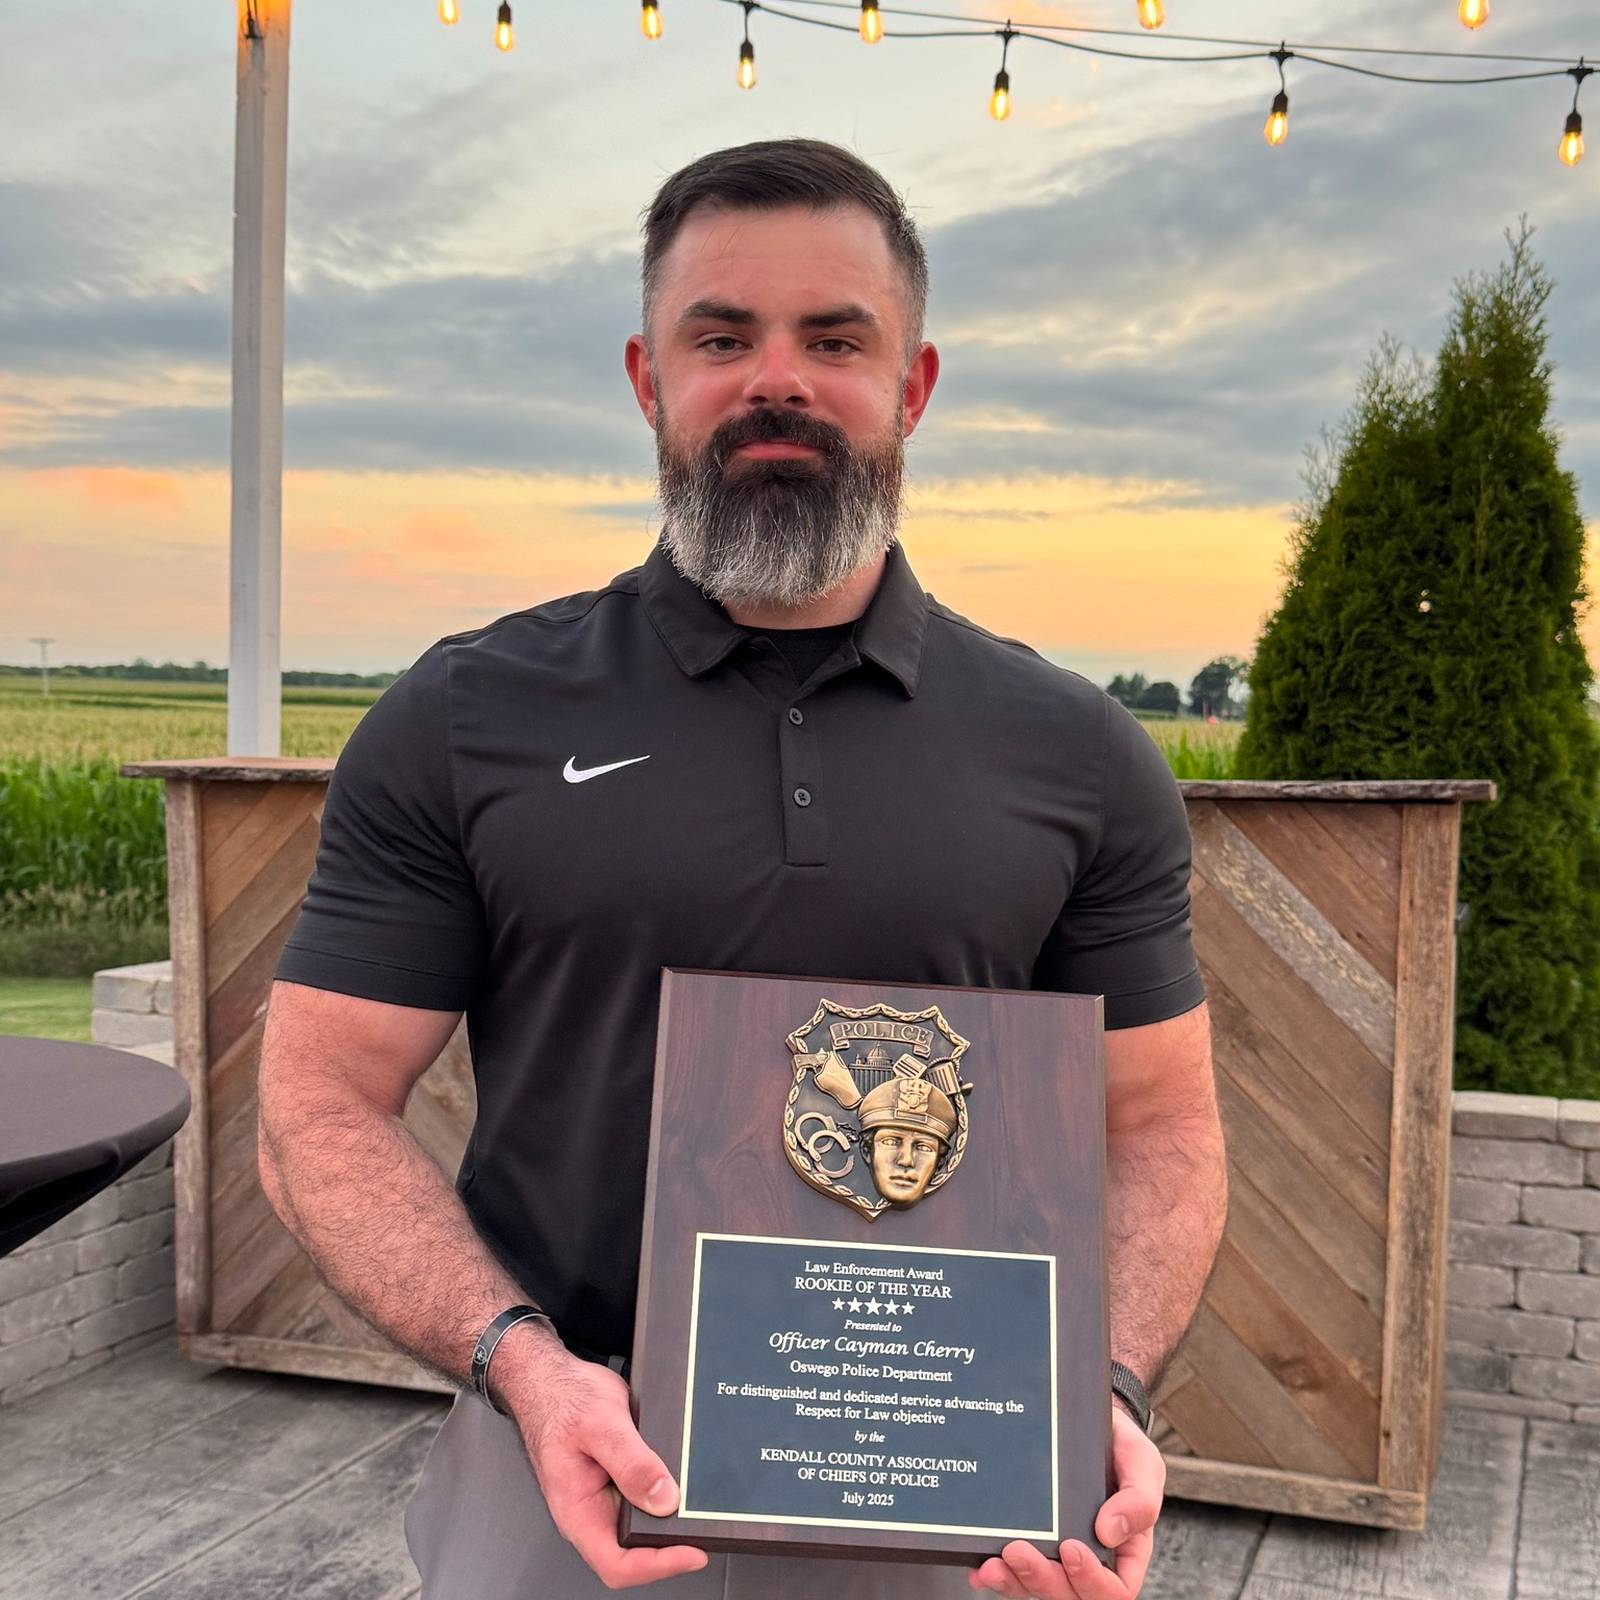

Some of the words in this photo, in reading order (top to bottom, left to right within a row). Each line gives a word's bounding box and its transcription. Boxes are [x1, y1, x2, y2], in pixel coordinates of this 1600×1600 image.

[841, 1022, 928, 1043] POLICE
[804, 1261, 830, 1273] Law
[833, 1263, 905, 1277] Enforcement
[906, 1269, 943, 1281] Award
[794, 1277, 852, 1292] ROOKIE
[855, 1282, 876, 1293] OF
[878, 1282, 908, 1295] THE
[910, 1284, 952, 1298] YEAR
[844, 1319, 889, 1332] Presented
[891, 1323, 902, 1332] to
[769, 1332, 830, 1352] Officer
[834, 1337, 909, 1357] Cayman
[913, 1342, 975, 1363] Cherry
[790, 1360, 839, 1377] Oswego
[841, 1363, 880, 1377] Police
[882, 1366, 952, 1383] Department
[717, 1383, 738, 1394] For
[740, 1384, 817, 1401] distinguished
[819, 1388, 841, 1401] and
[843, 1390, 899, 1404] dedicated
[901, 1394, 942, 1408] service
[944, 1397, 1004, 1414] advancing
[1005, 1400, 1024, 1413] the
[795, 1404, 841, 1421] Respect
[844, 1407, 862, 1419] for
[864, 1408, 890, 1421] Law
[892, 1410, 946, 1425] objective
[854, 1432, 867, 1444] by
[869, 1432, 885, 1443] the
[760, 1448, 825, 1463] KENDALL
[828, 1452, 887, 1467] COUNTY
[887, 1456, 977, 1472] ASSOCIATION
[797, 1467, 817, 1480] OF
[819, 1469, 866, 1483] CHIEFS
[869, 1472, 888, 1485] OF
[890, 1474, 939, 1488] POLICE
[841, 1491, 865, 1506] July
[867, 1494, 894, 1506] 2025
